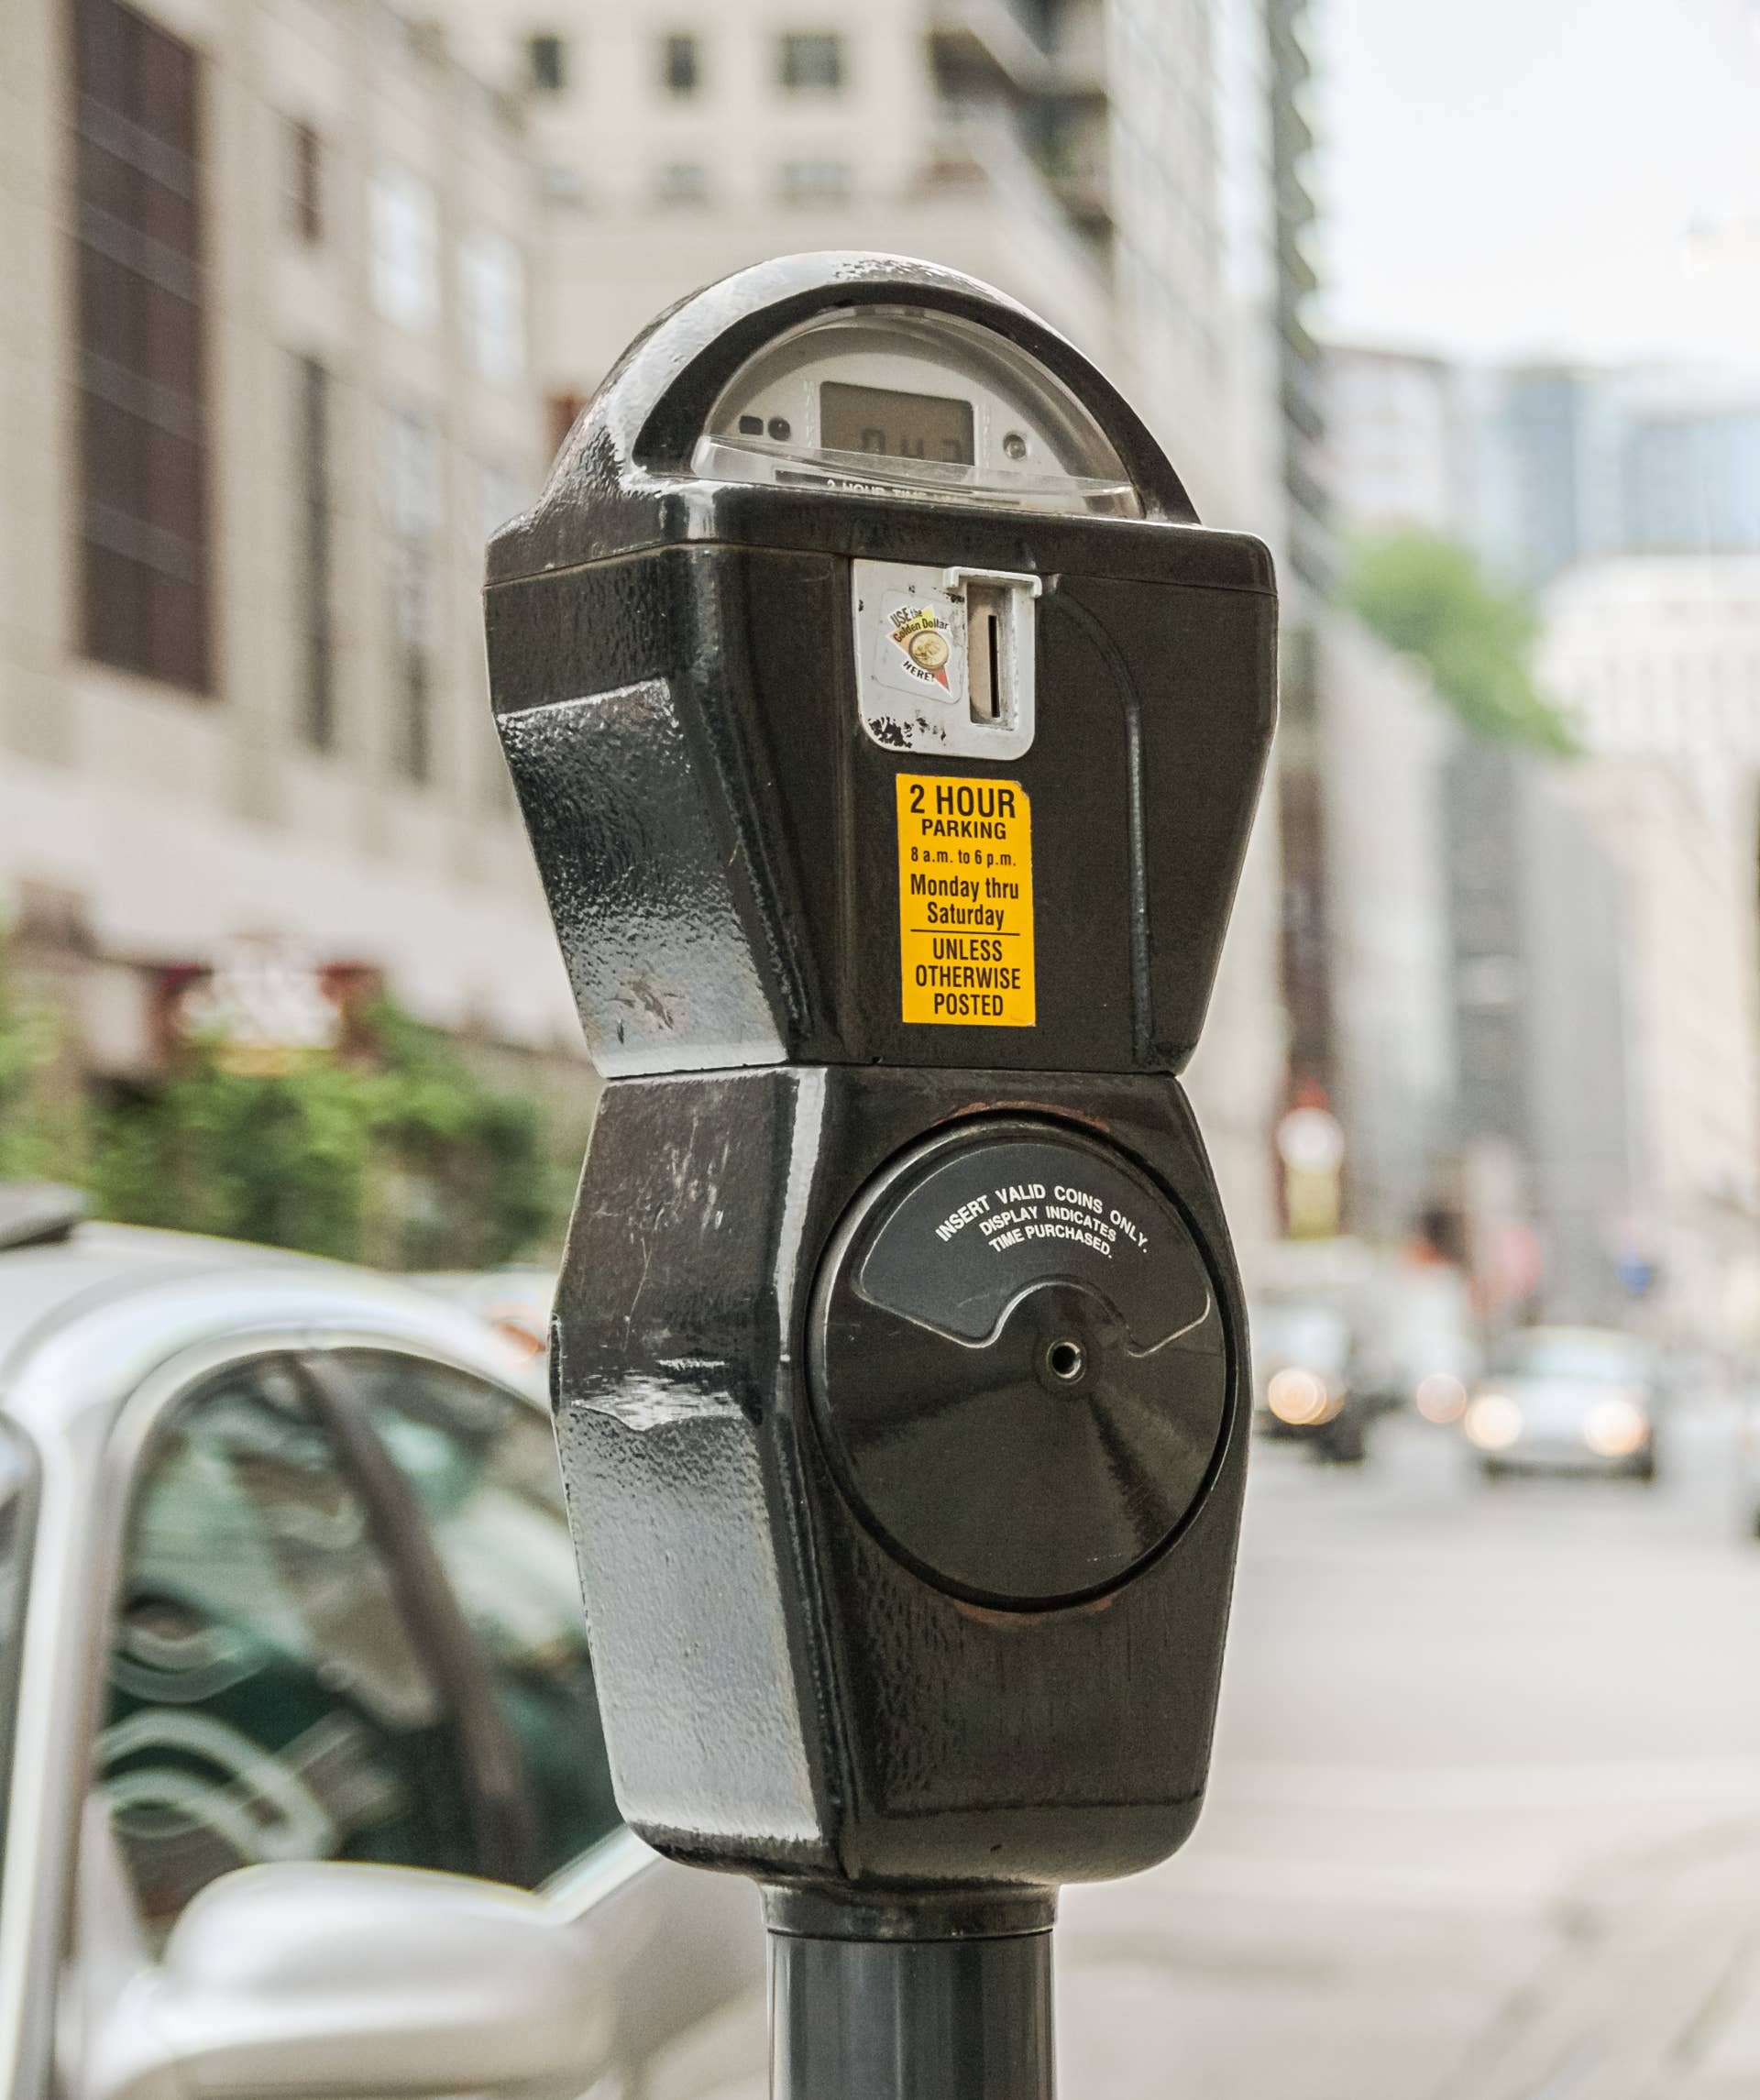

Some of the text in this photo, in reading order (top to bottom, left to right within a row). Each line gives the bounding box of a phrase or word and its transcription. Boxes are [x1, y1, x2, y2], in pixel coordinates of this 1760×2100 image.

[890, 607, 923, 628] USE the
[893, 618, 948, 643] Golden Dollar
[903, 660, 935, 682] HERE!
[909, 784, 1016, 819] 2 HOUR
[921, 819, 1006, 840] PARKING
[910, 846, 1017, 868] 8 a.m. to 6 p.m.
[910, 874, 1018, 902] Monday thru
[927, 901, 1004, 930] Saturday
[933, 938, 1003, 962] UNLESS
[916, 964, 1021, 989] OTHERWISE
[934, 993, 1004, 1017] POSTED
[935, 1183, 1149, 1253] INSERT VALID COINS ONLY.
[979, 1205, 1116, 1242] DISPLAY INDICATES
[988, 1224, 1113, 1259] TIME PURCHASED.
